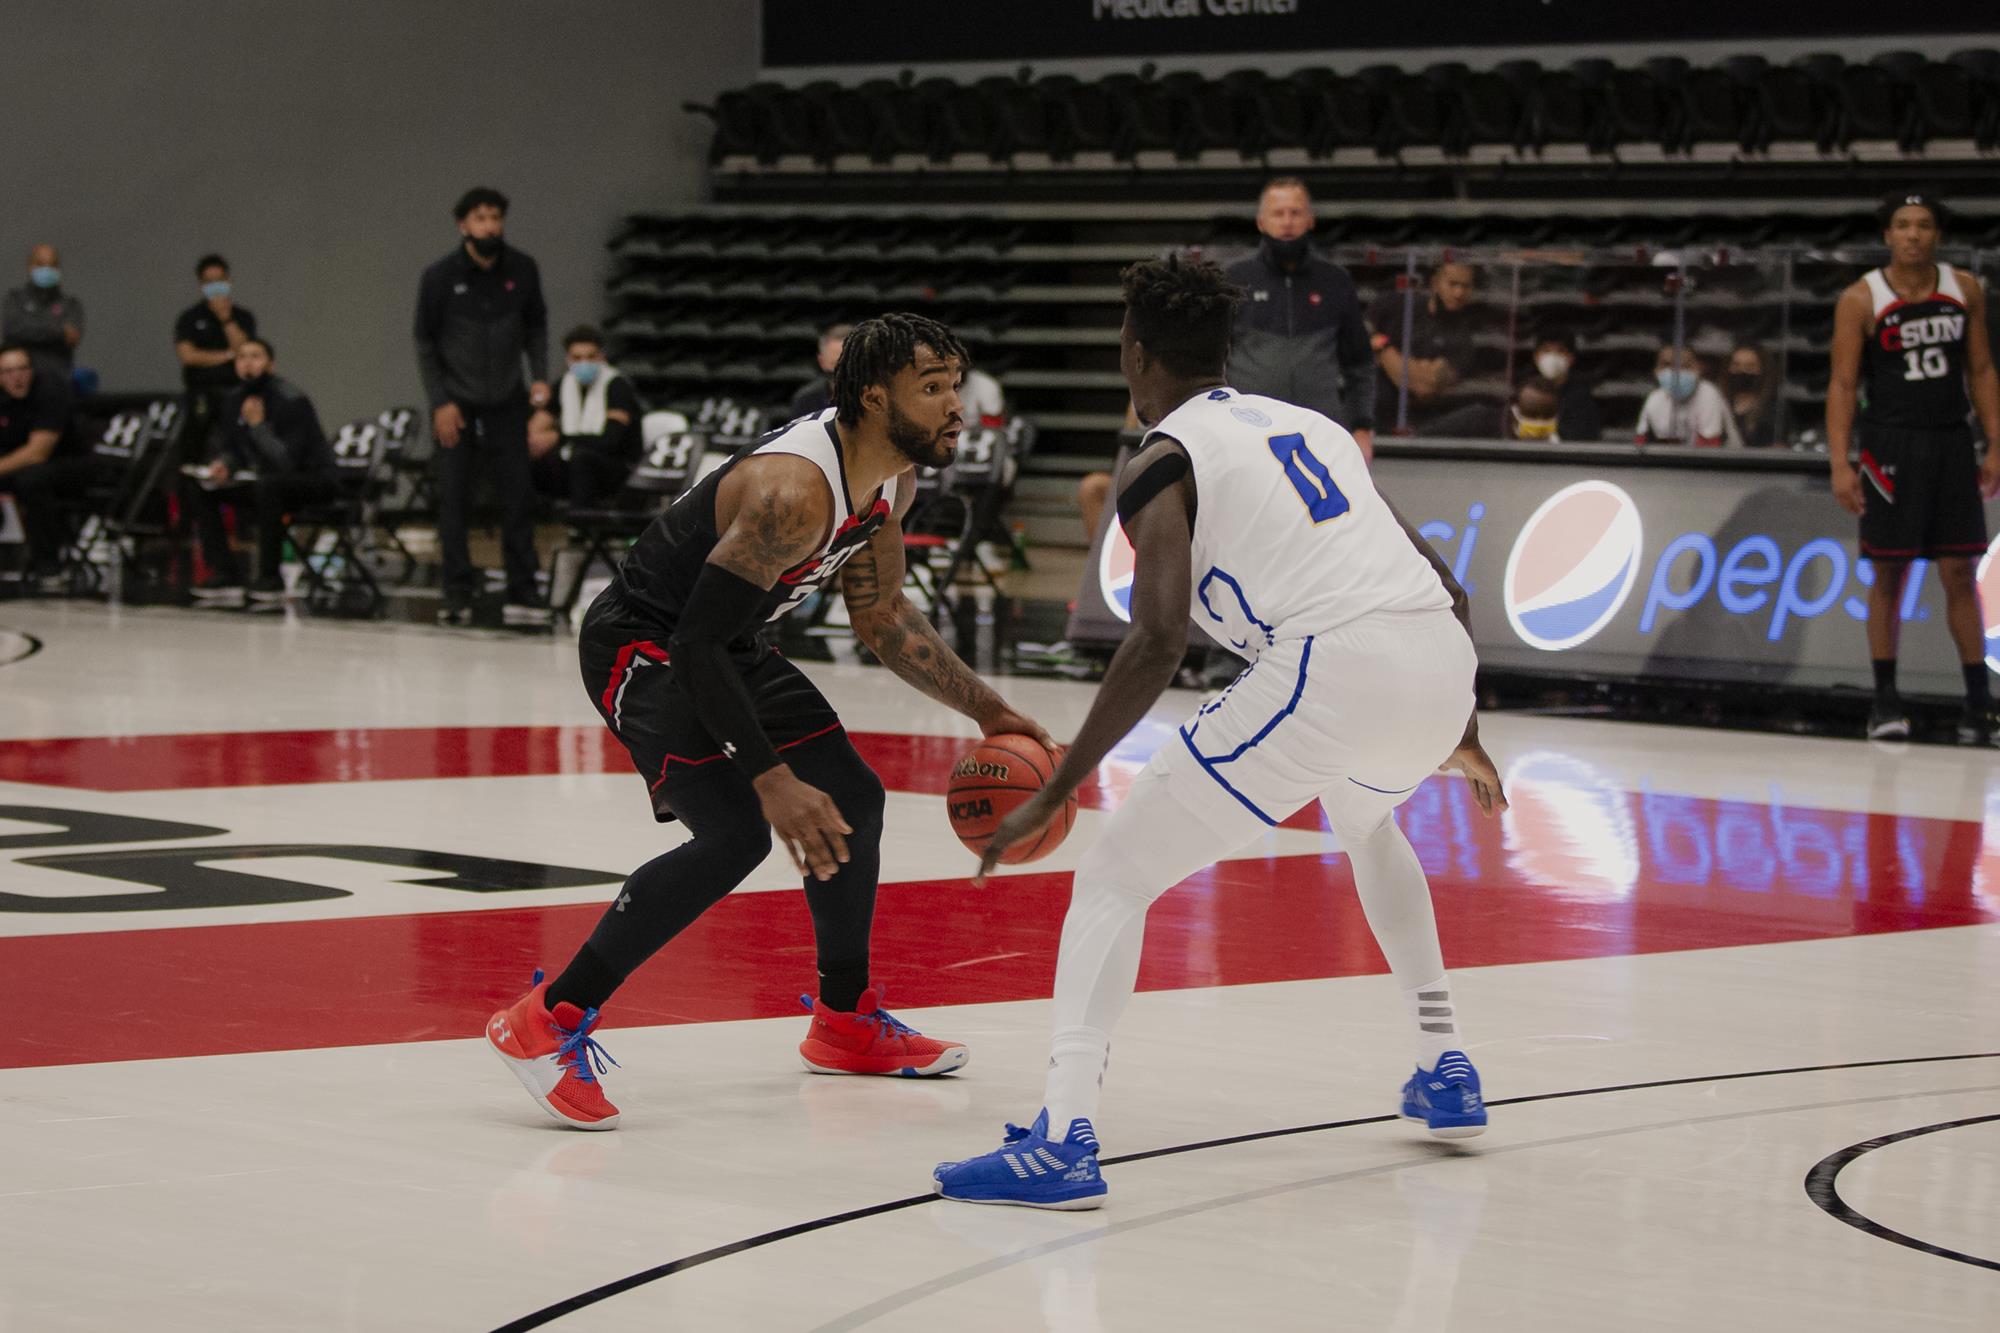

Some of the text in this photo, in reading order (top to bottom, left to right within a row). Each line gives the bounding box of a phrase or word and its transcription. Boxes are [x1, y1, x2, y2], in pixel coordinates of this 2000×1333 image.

[1880, 314, 1965, 352] CSUN
[1903, 347, 1949, 381] 10
[1265, 431, 1352, 528] 0
[951, 755, 1009, 782] ilson
